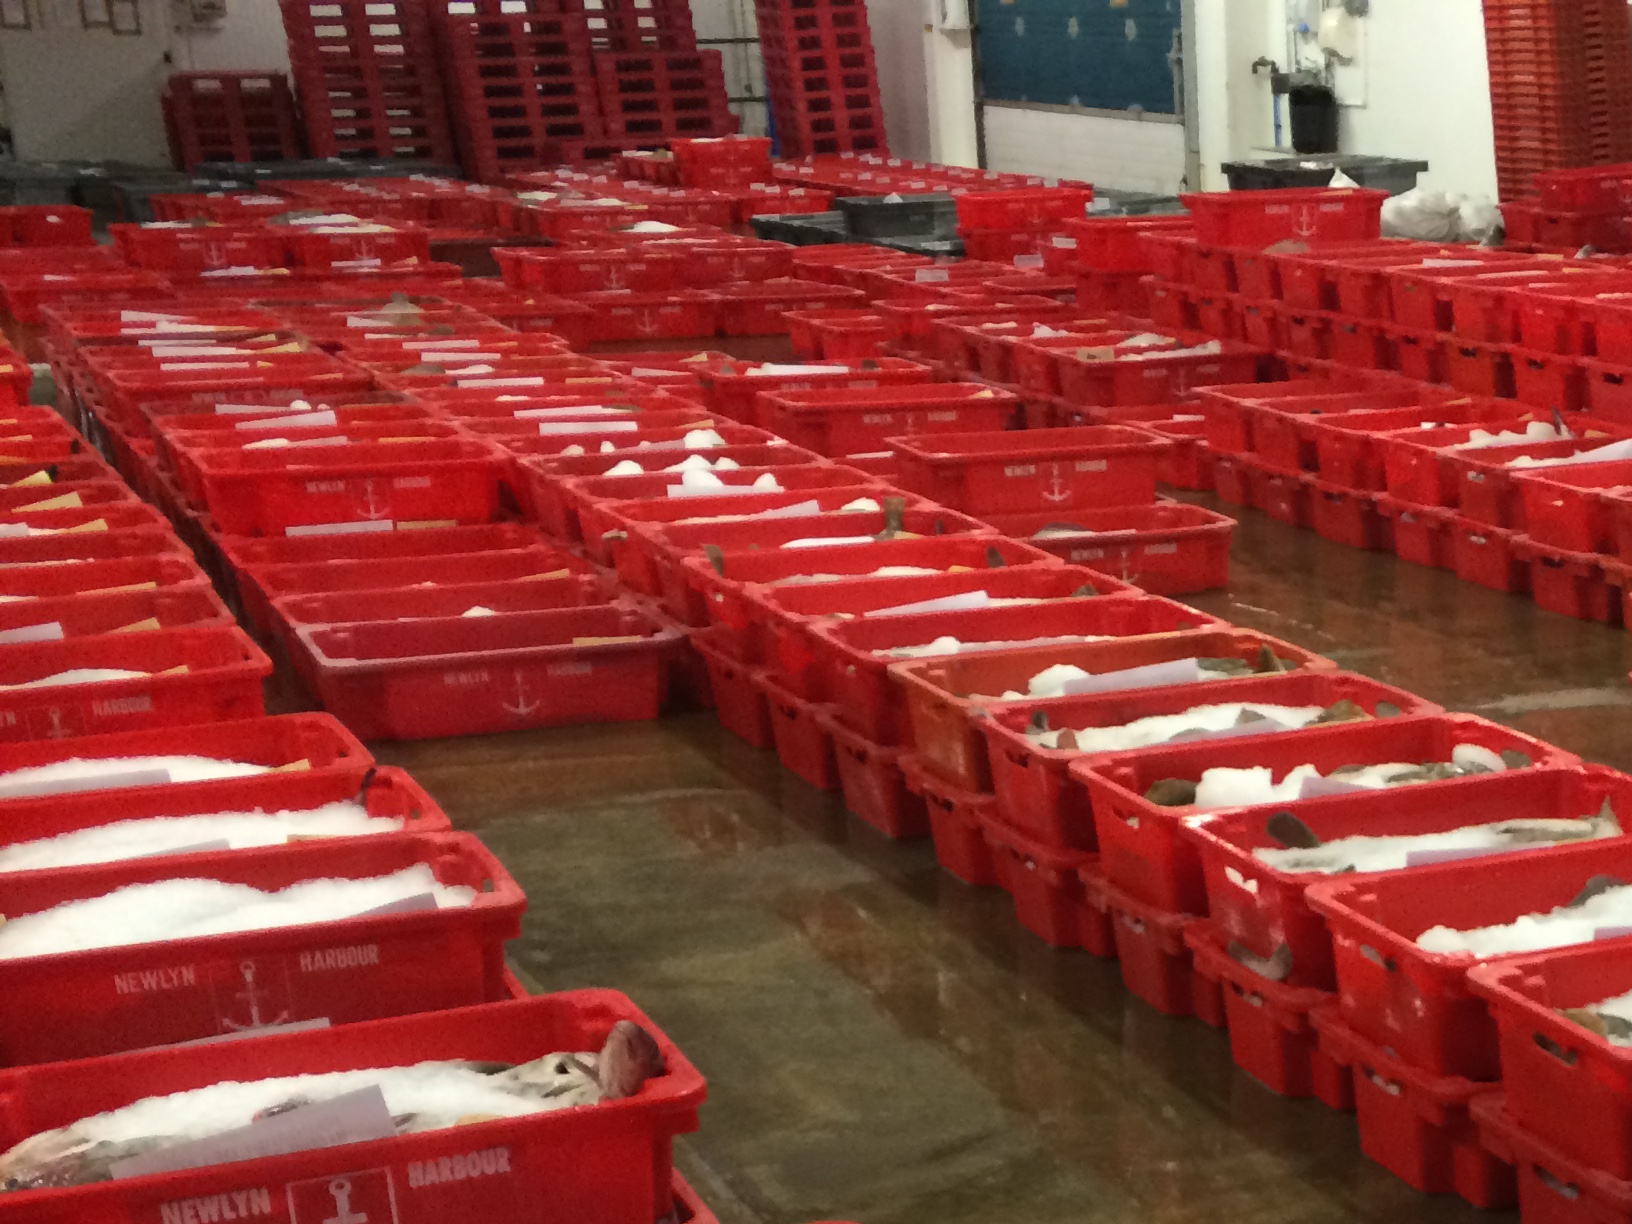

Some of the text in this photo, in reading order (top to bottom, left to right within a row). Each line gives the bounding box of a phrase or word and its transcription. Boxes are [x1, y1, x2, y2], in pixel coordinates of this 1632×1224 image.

[114, 944, 380, 994] NEWLYN HARBOUR
[407, 1146, 512, 1189] HARBOUR
